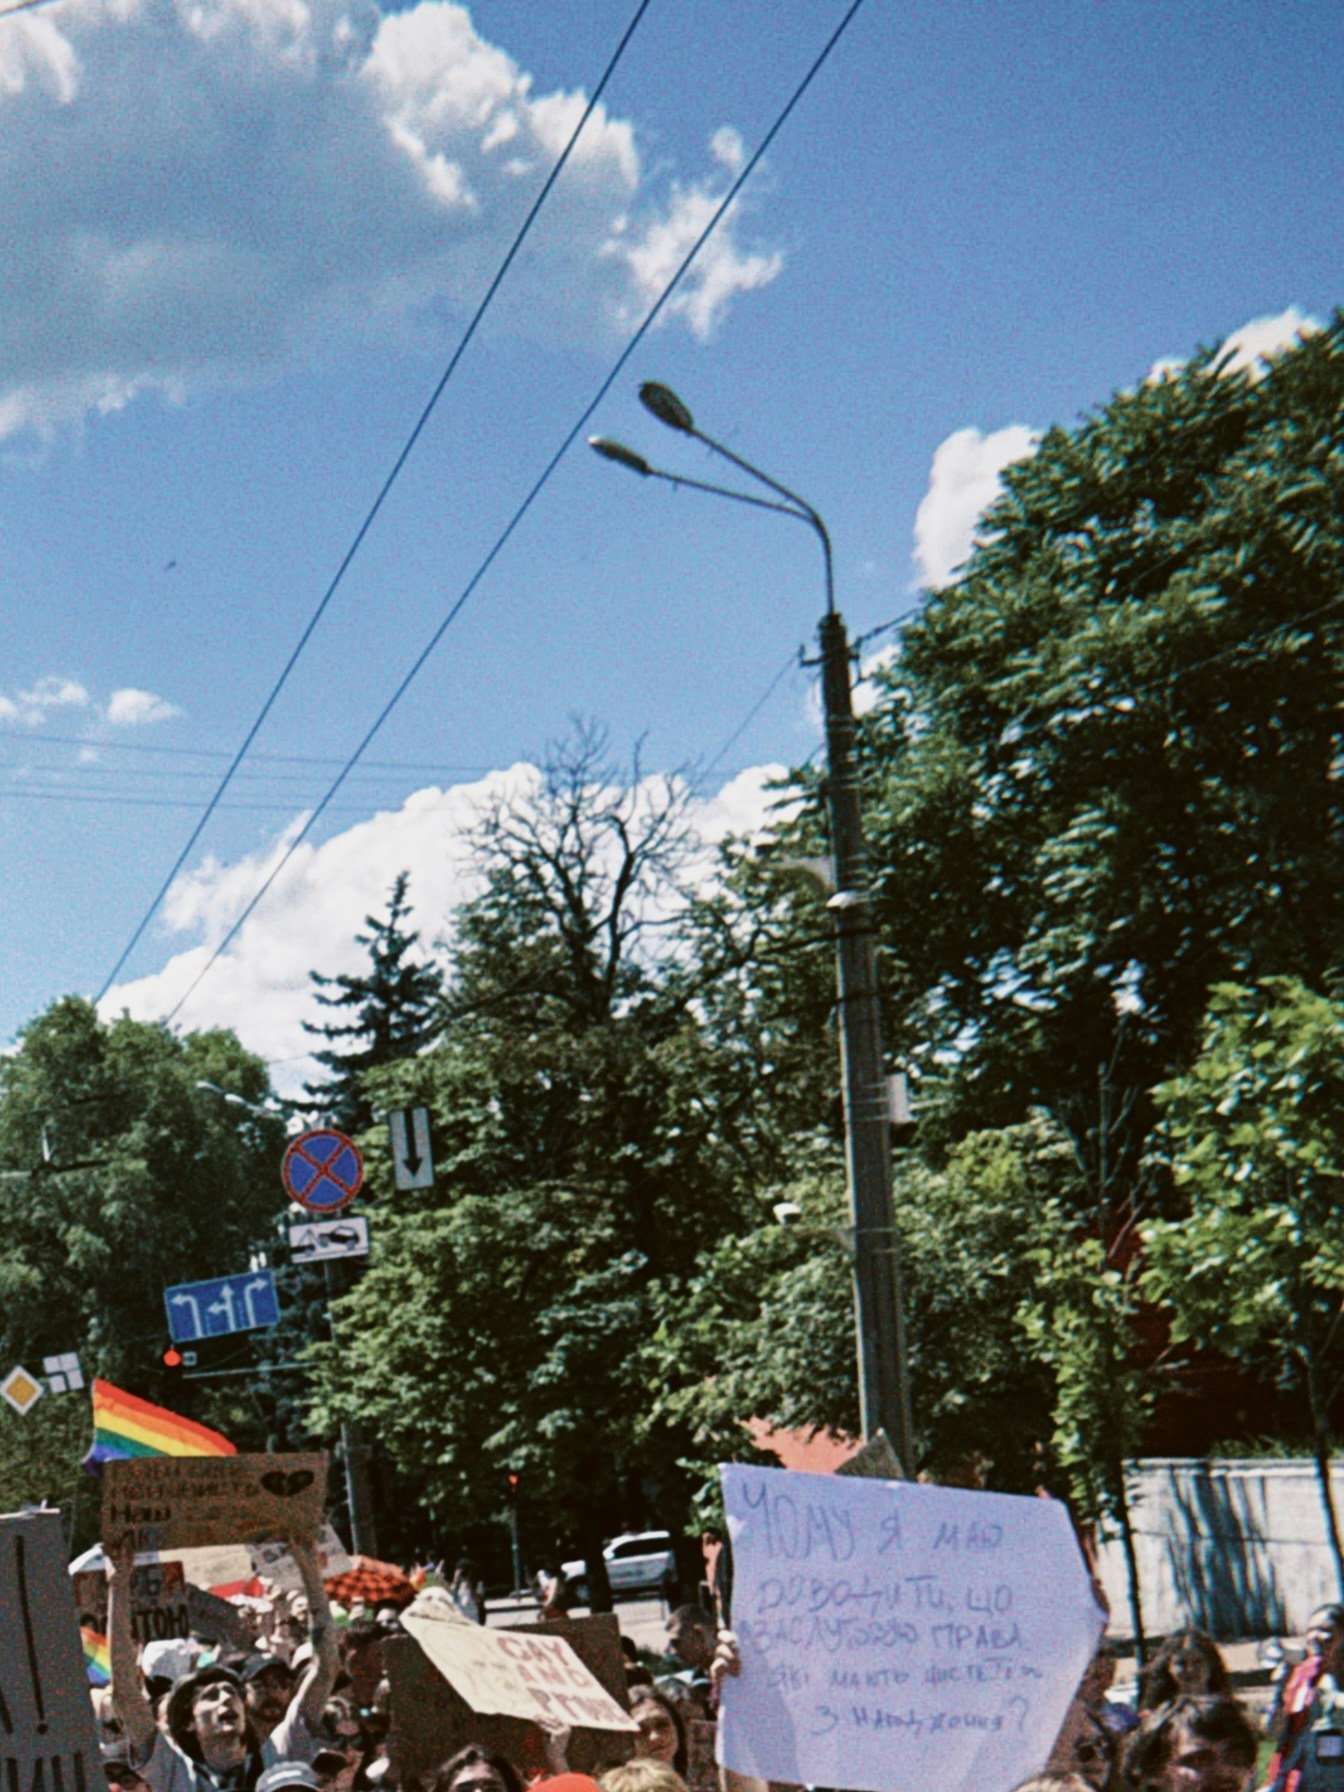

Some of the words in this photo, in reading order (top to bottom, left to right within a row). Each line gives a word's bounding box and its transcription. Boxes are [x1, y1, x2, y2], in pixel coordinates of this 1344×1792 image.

[743, 1482, 856, 1561] ЧОМУ
[878, 1509, 903, 1555] Я
[933, 1521, 1003, 1551] МАЮ
[496, 1635, 570, 1667] GAY
[516, 1662, 594, 1689] AND
